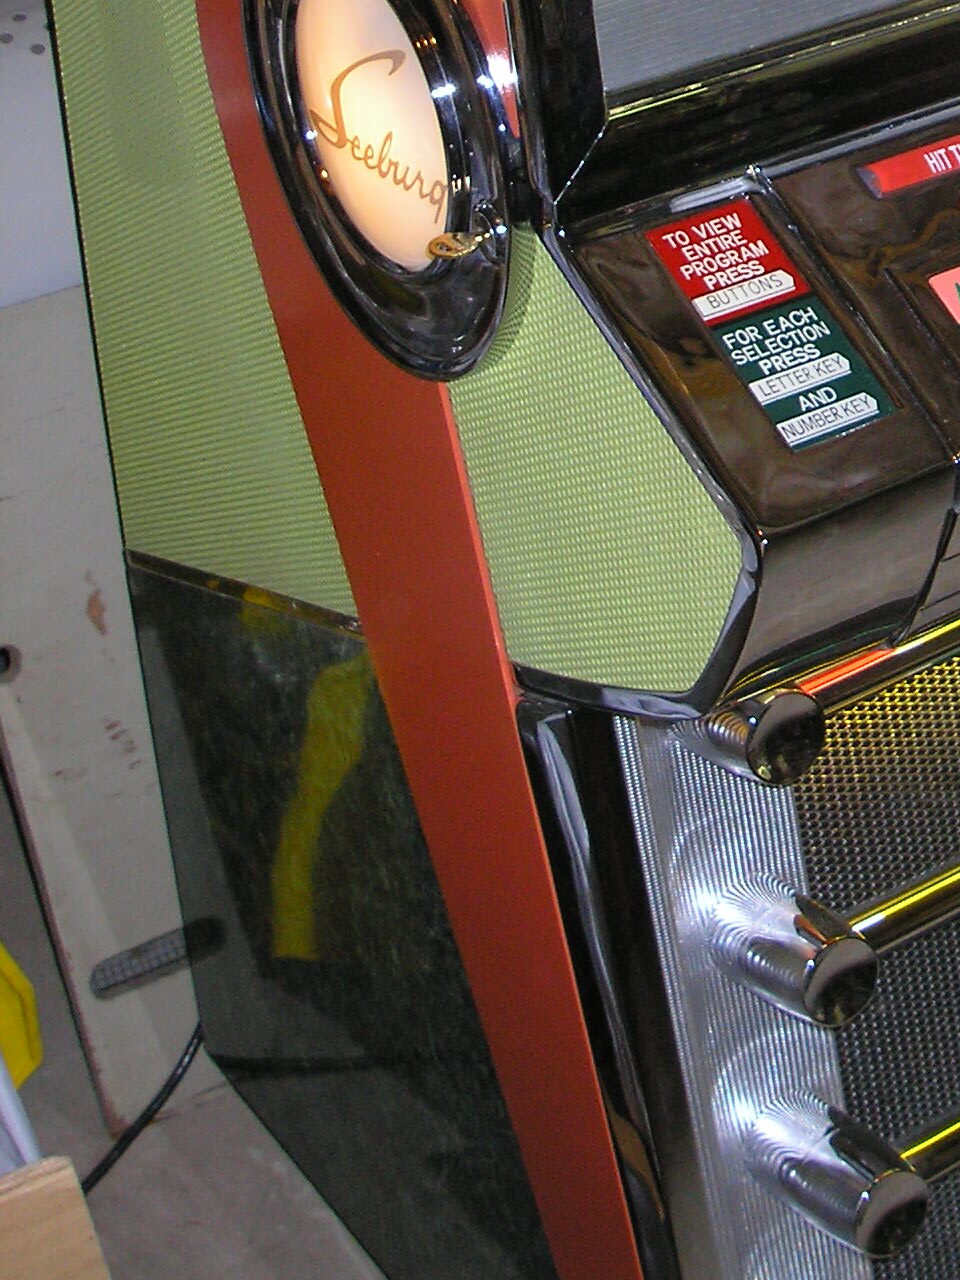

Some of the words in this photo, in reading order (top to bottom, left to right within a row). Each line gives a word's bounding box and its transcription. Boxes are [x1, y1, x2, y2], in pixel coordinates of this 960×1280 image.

[310, 49, 450, 223] Seeburg
[923, 147, 947, 174] HIT
[662, 231, 690, 250] TO
[691, 212, 743, 241] VIEW
[683, 230, 748, 260] ENTIRE
[680, 239, 770, 281] PROGRAM
[704, 260, 766, 291] PRESS
[708, 274, 783, 309] BUTTONS
[722, 325, 761, 350] FOR
[762, 306, 819, 335] EACH
[730, 320, 831, 366] SELECTION
[758, 364, 815, 397] LETTER
[815, 355, 850, 377] KEY
[760, 343, 821, 376] PRESS
[782, 406, 842, 440] NUMBER
[841, 395, 876, 418] KEY
[798, 386, 838, 411] AND
